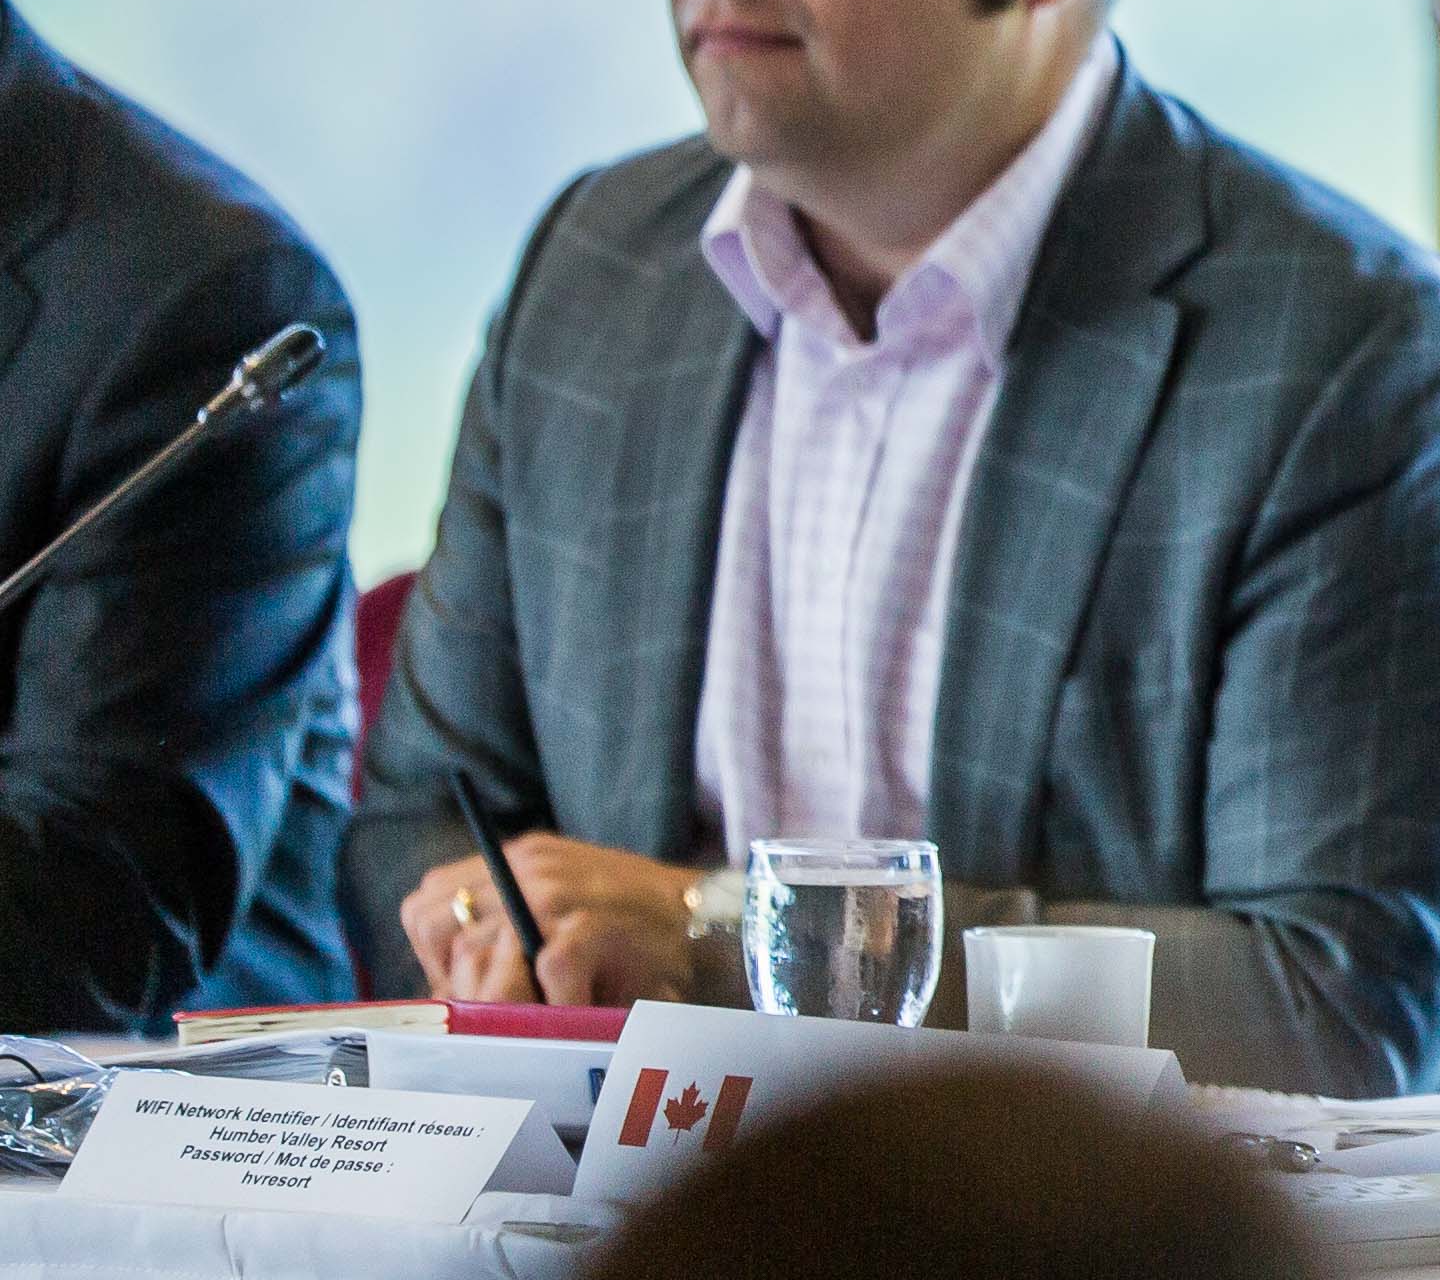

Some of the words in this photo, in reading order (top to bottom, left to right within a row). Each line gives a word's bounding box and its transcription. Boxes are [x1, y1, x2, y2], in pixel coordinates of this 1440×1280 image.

[136, 1099, 173, 1115] WIFI
[174, 1102, 243, 1121] Network
[245, 1107, 320, 1126] Identifier
[320, 1113, 331, 1127] /
[331, 1114, 416, 1134] Identifiant
[417, 1120, 474, 1137] réseau
[209, 1126, 276, 1144] Humber
[281, 1131, 328, 1152] Valley
[331, 1135, 388, 1152] Resort
[180, 1145, 264, 1165] Password
[263, 1151, 274, 1165] /
[274, 1152, 308, 1168] Mot
[309, 1154, 331, 1169] de
[331, 1158, 384, 1173] passe
[241, 1170, 312, 1189] hvresort
